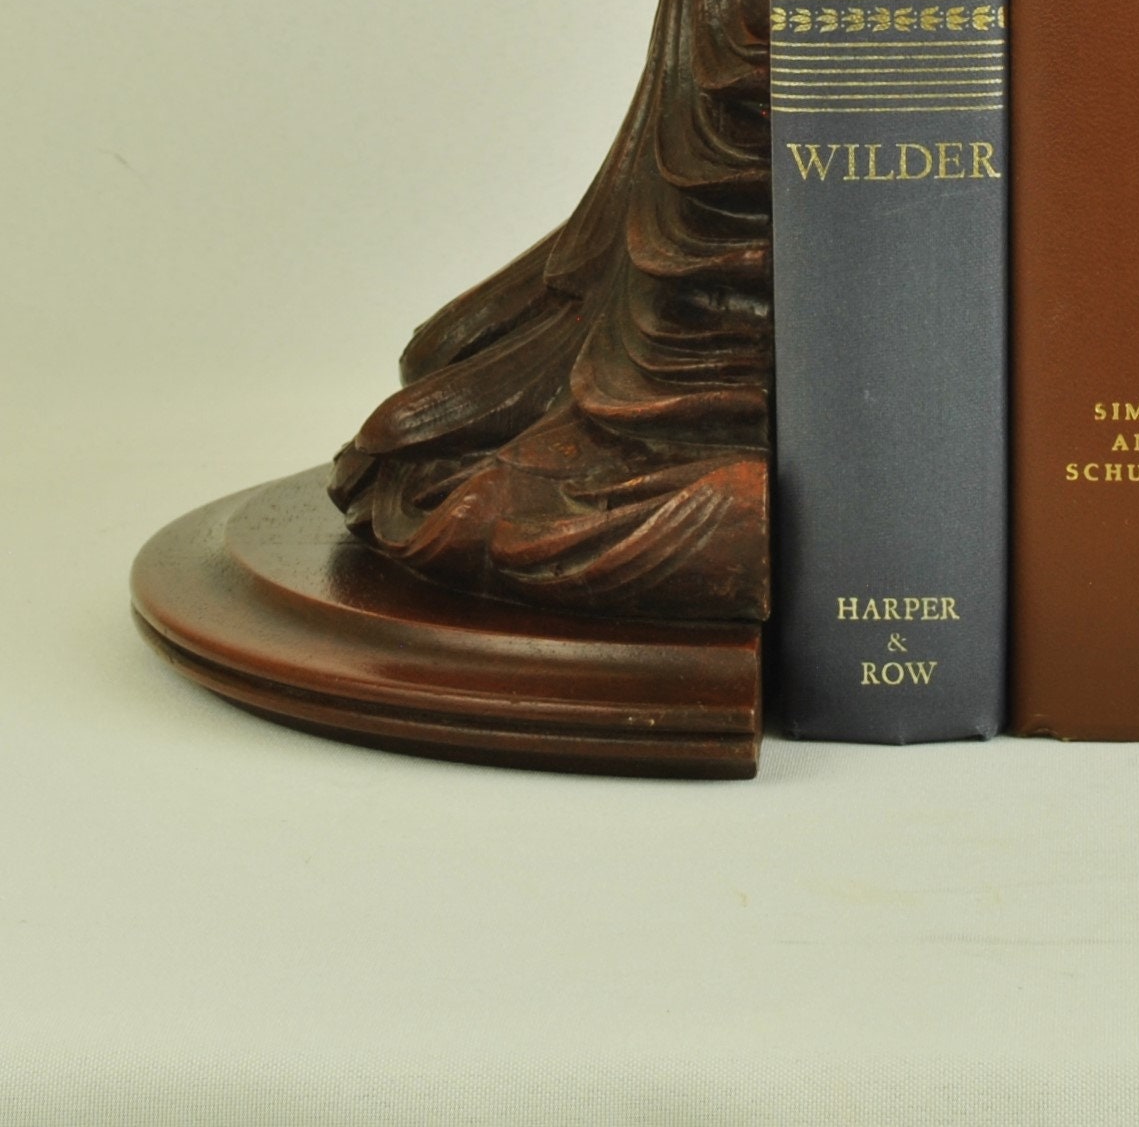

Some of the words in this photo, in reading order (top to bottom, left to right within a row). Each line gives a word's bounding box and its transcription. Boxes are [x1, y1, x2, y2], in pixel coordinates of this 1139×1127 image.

[786, 142, 1002, 182] WILDER
[836, 596, 960, 621] HARPER
[887, 632, 908, 652] &
[860, 661, 938, 685] ROW
